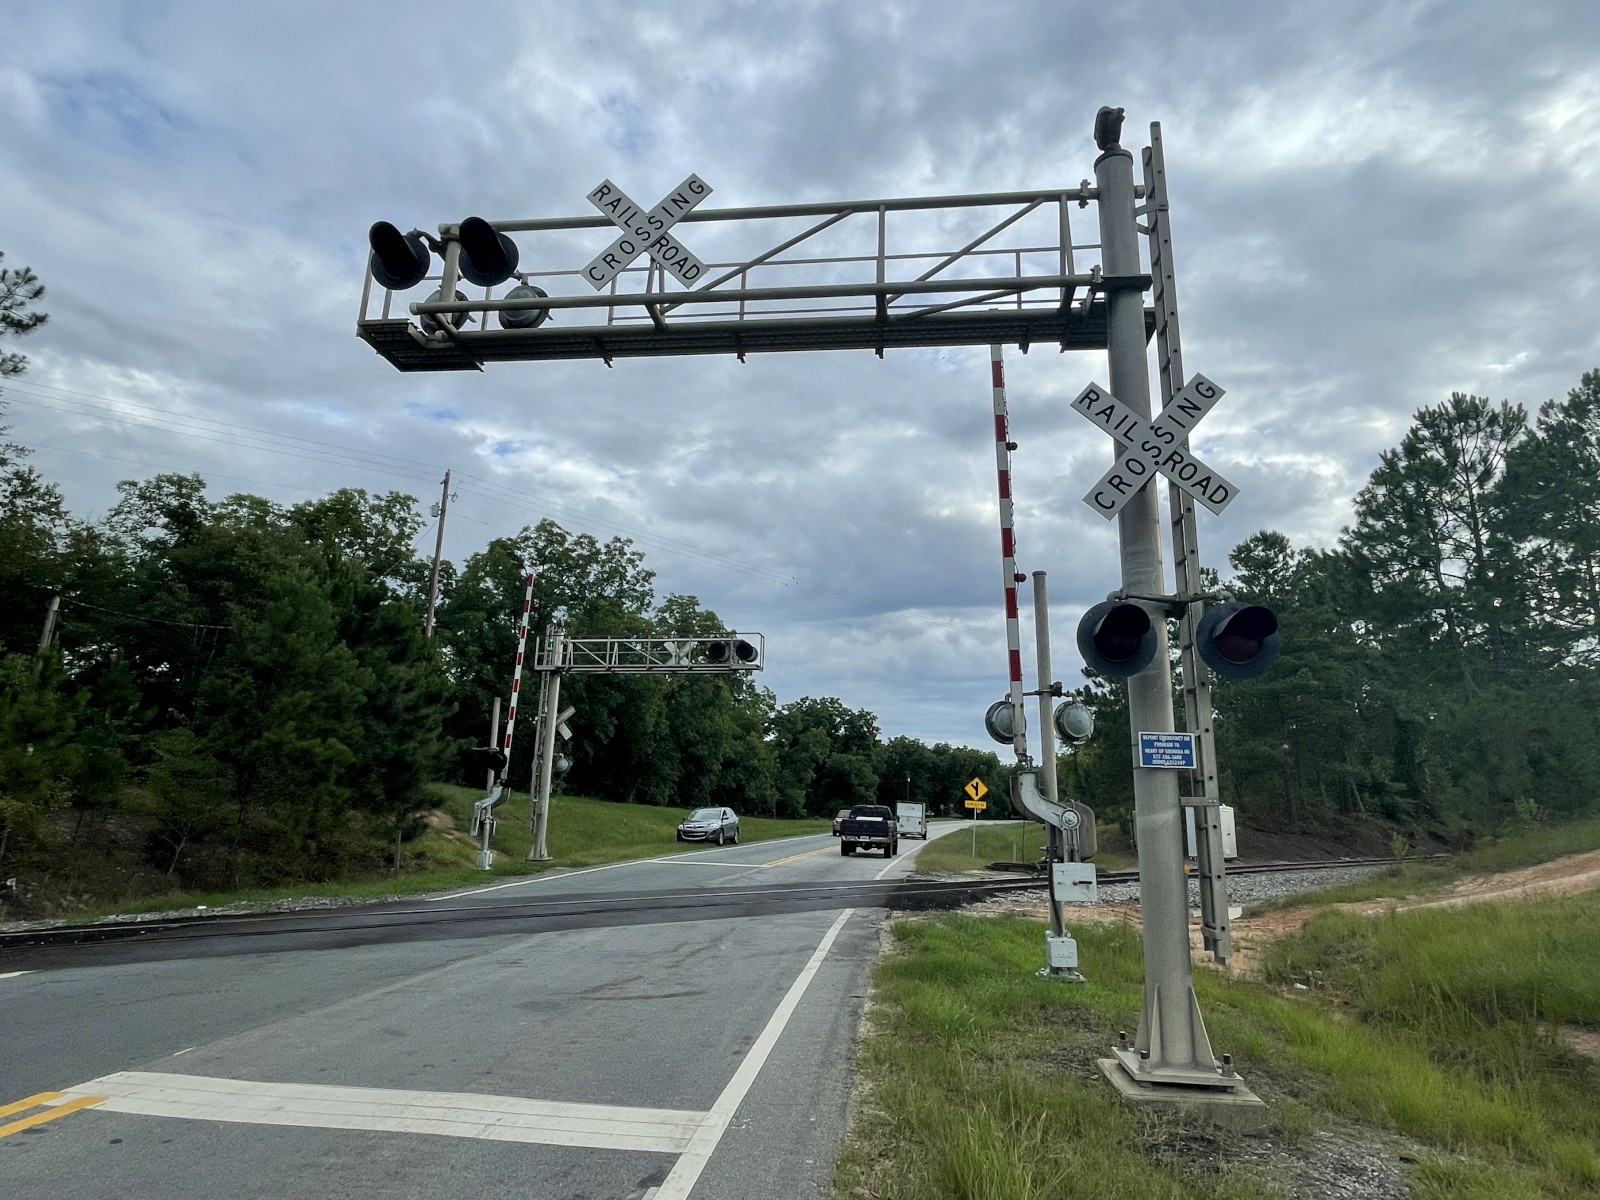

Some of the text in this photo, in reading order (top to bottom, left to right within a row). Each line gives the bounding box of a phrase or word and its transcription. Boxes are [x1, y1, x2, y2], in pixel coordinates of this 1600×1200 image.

[588, 180, 705, 281] CROSSING
[592, 184, 700, 281] RAIL ROAD
[1078, 388, 1229, 505] RAIL ROAD
[1094, 381, 1216, 510] CROSSING
